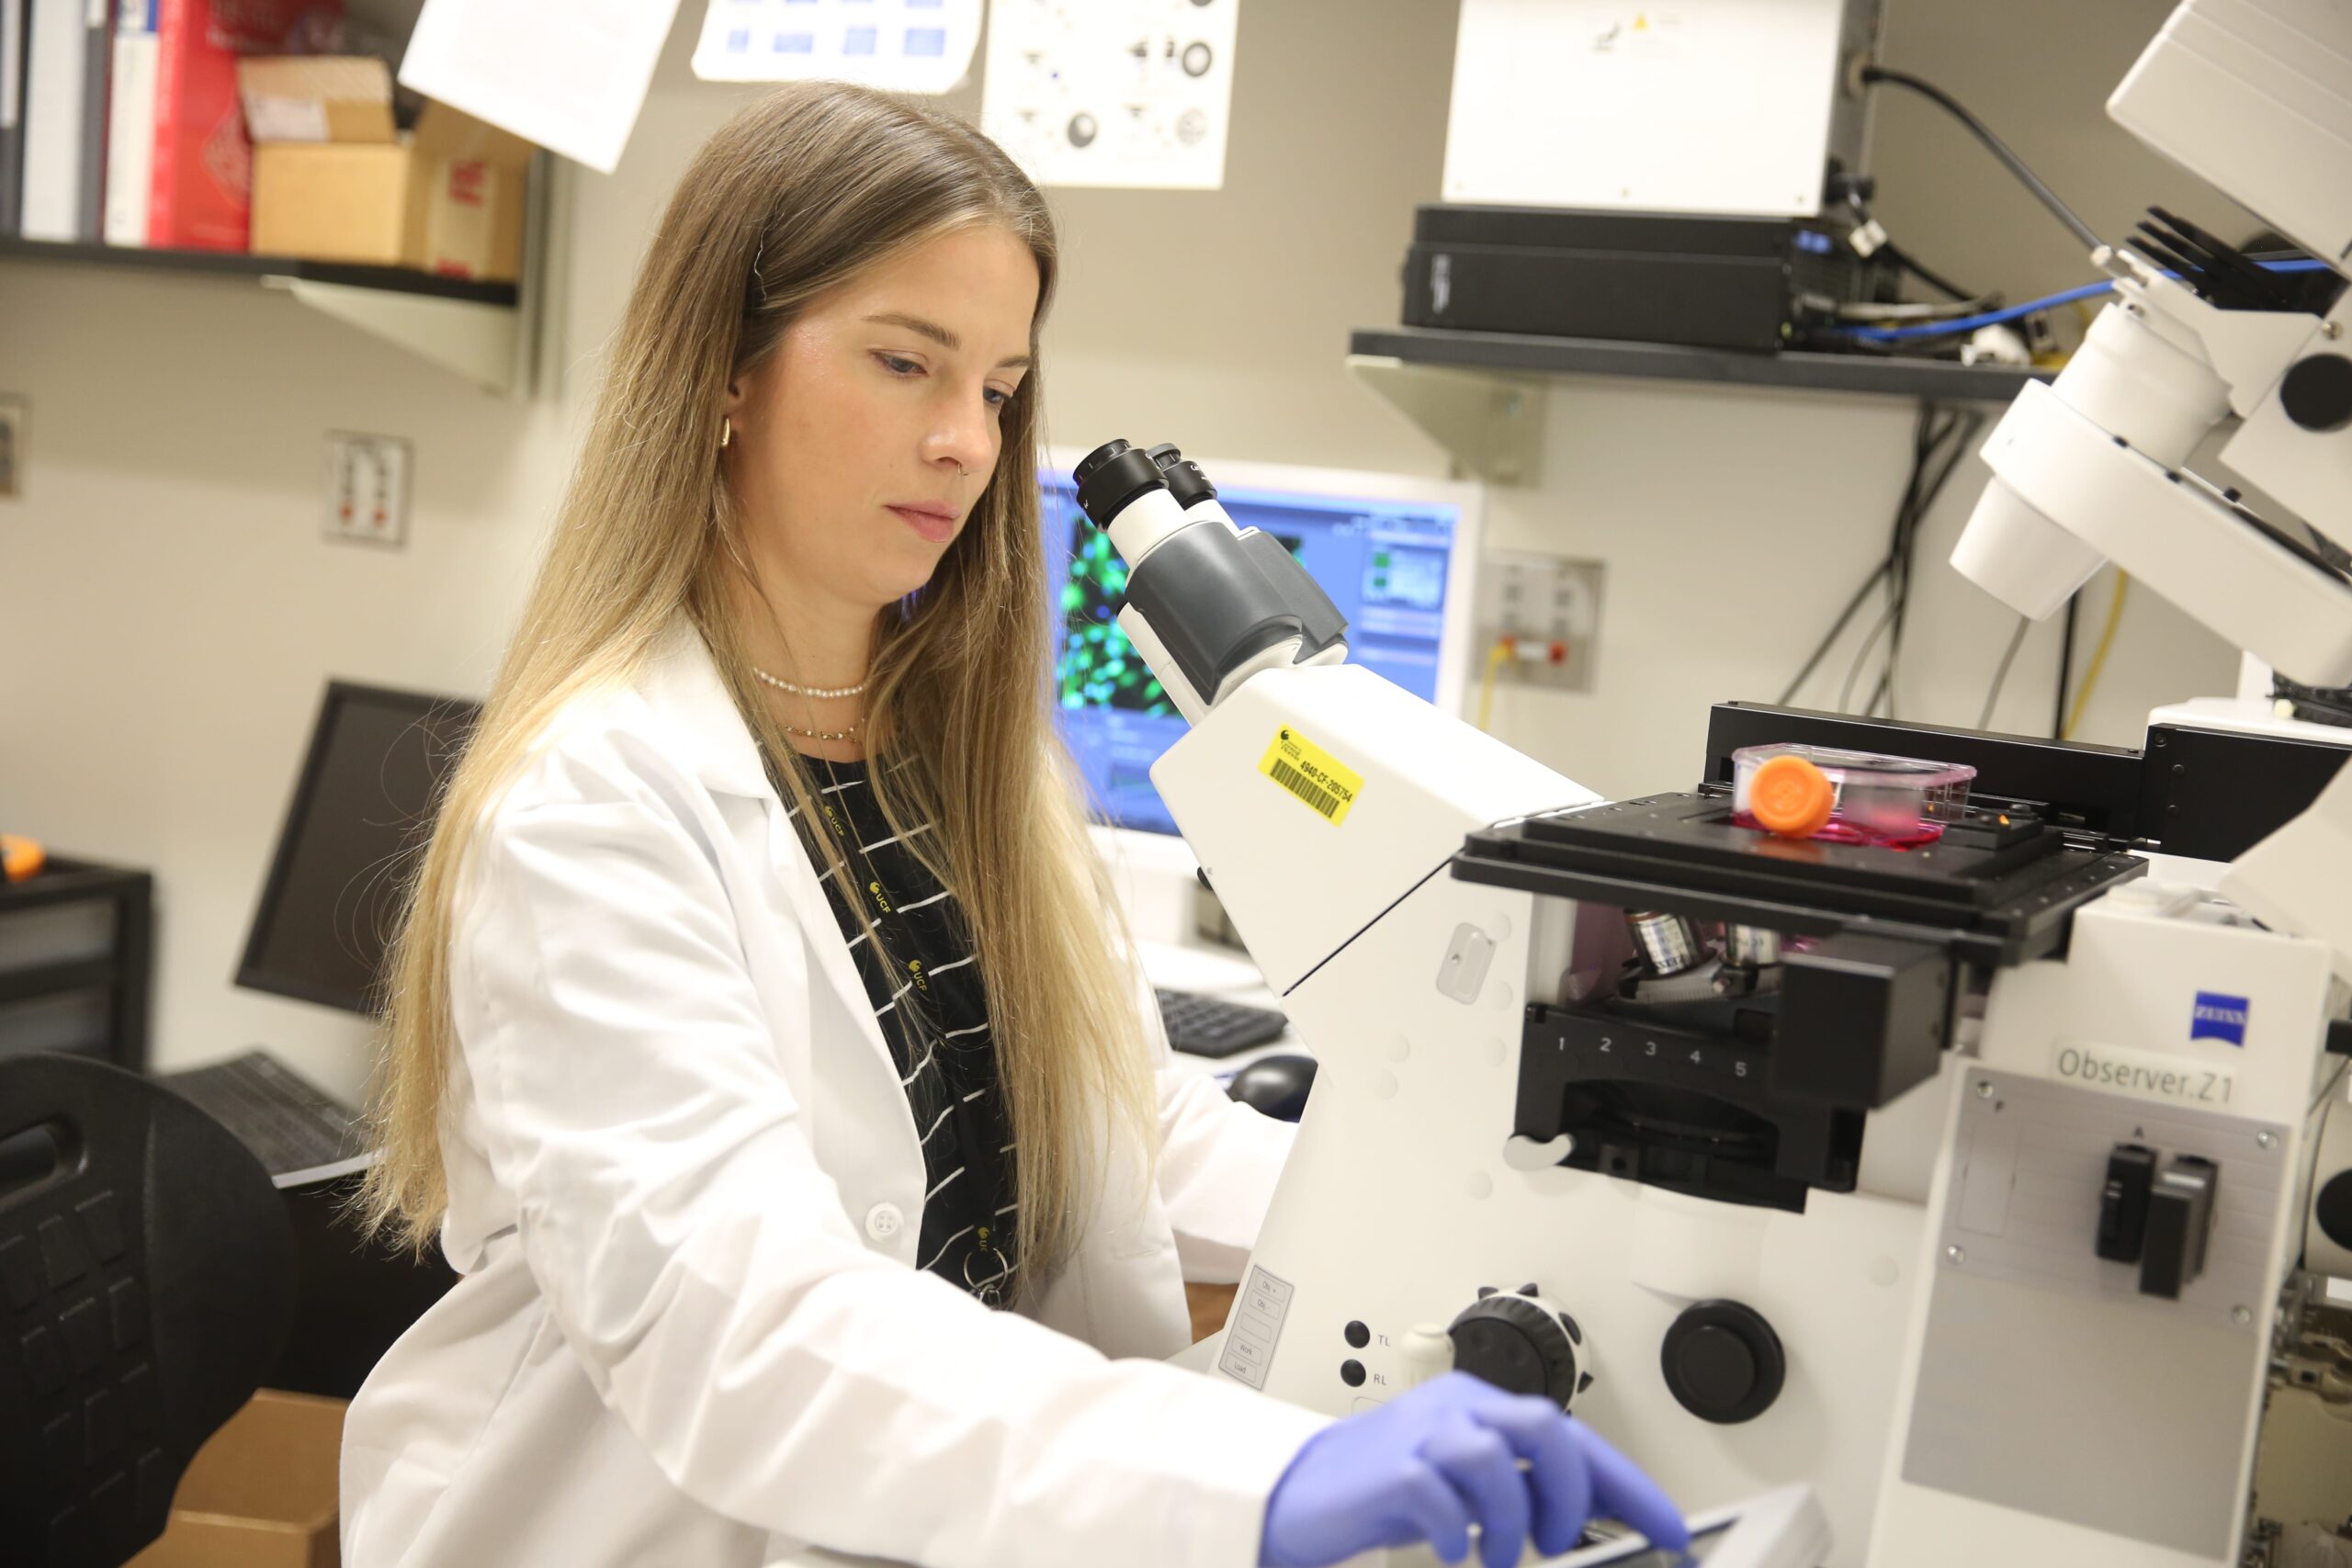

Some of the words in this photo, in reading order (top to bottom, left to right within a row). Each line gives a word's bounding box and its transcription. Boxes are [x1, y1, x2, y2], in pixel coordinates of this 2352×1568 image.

[830, 817, 844, 837] UCF
[876, 894, 891, 914] UCF
[913, 973, 928, 993] UCF
[2195, 1005, 2245, 1025] ZEISS
[1559, 1037, 1565, 1051] 1
[1600, 1037, 1611, 1052] 2
[1645, 1042, 1657, 1056] 3
[1690, 1050, 1701, 1064] 4
[1735, 1062, 1747, 1077] 5
[2058, 1049, 2233, 1103] Observer.Z1
[1377, 1335, 1390, 1347] TL
[1374, 1373, 1387, 1386] RL
